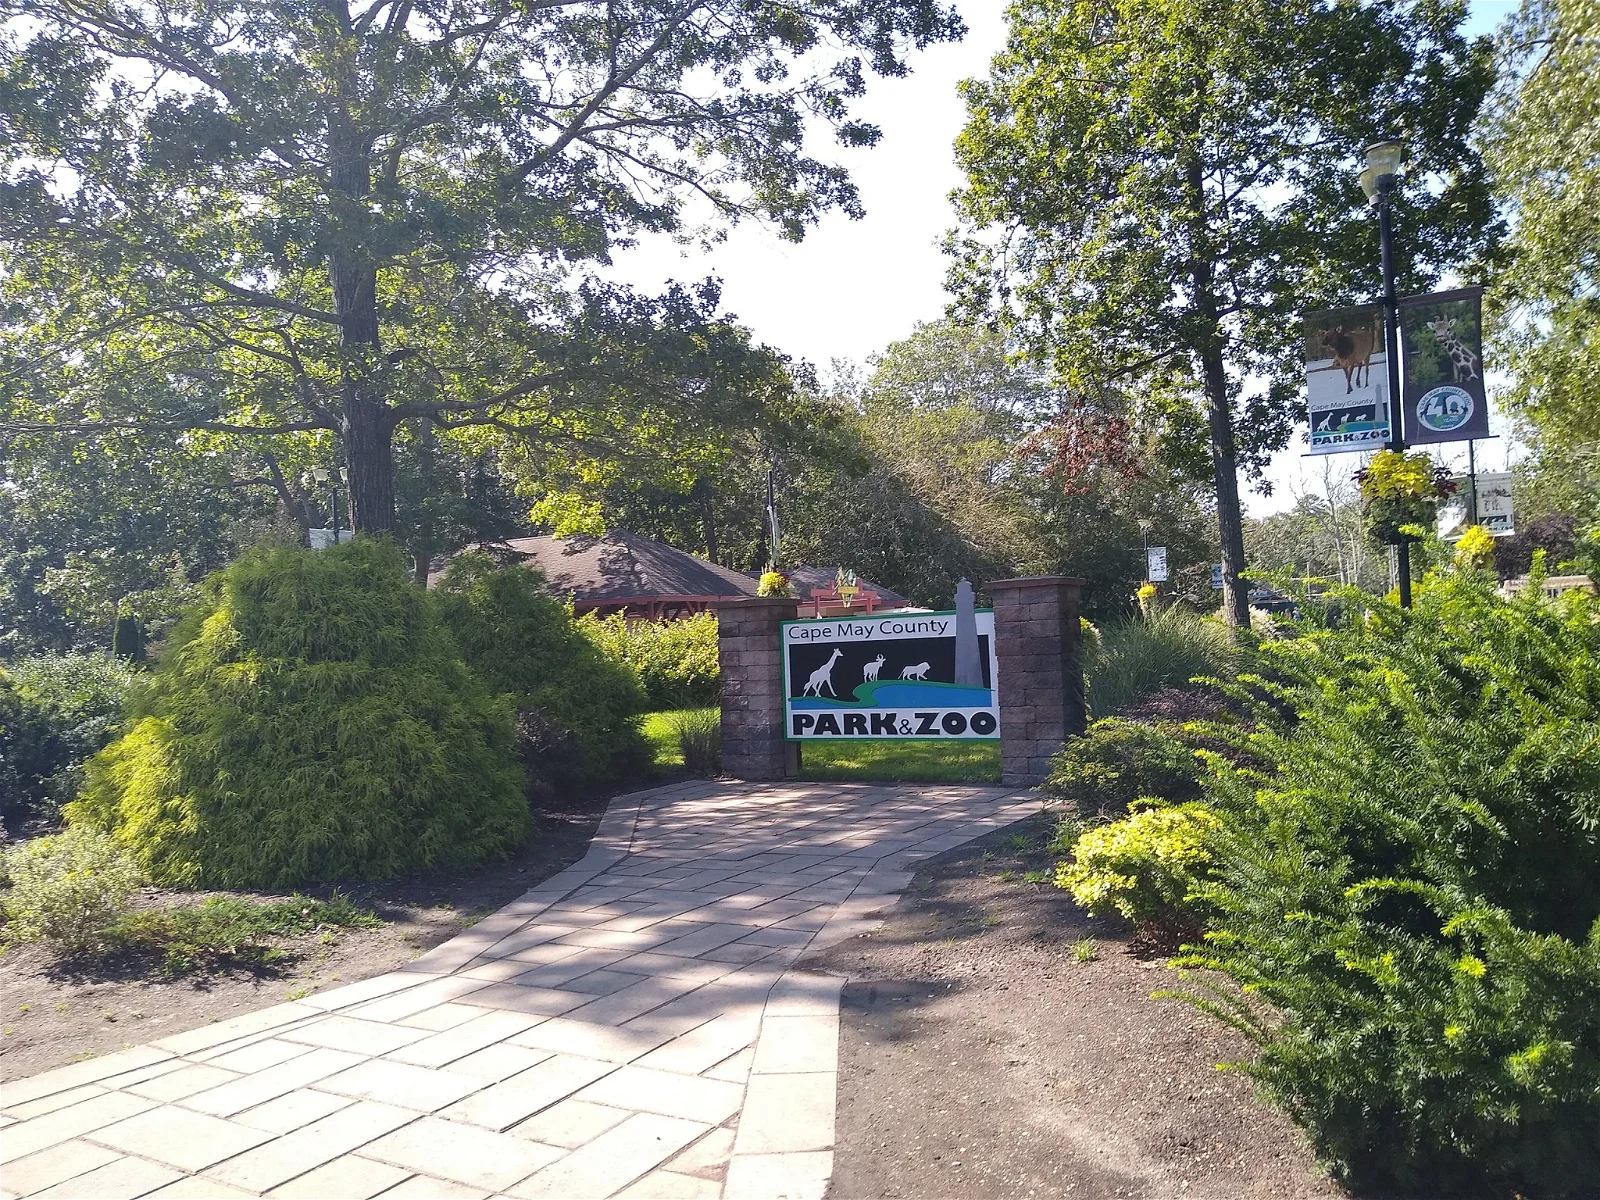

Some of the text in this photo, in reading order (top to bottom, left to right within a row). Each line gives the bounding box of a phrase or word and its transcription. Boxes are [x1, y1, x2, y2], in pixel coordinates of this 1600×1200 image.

[1441, 387, 1465, 396] COUNTY
[1331, 401, 1345, 410] May
[1347, 398, 1374, 407] County
[788, 619, 949, 641] Cape May County
